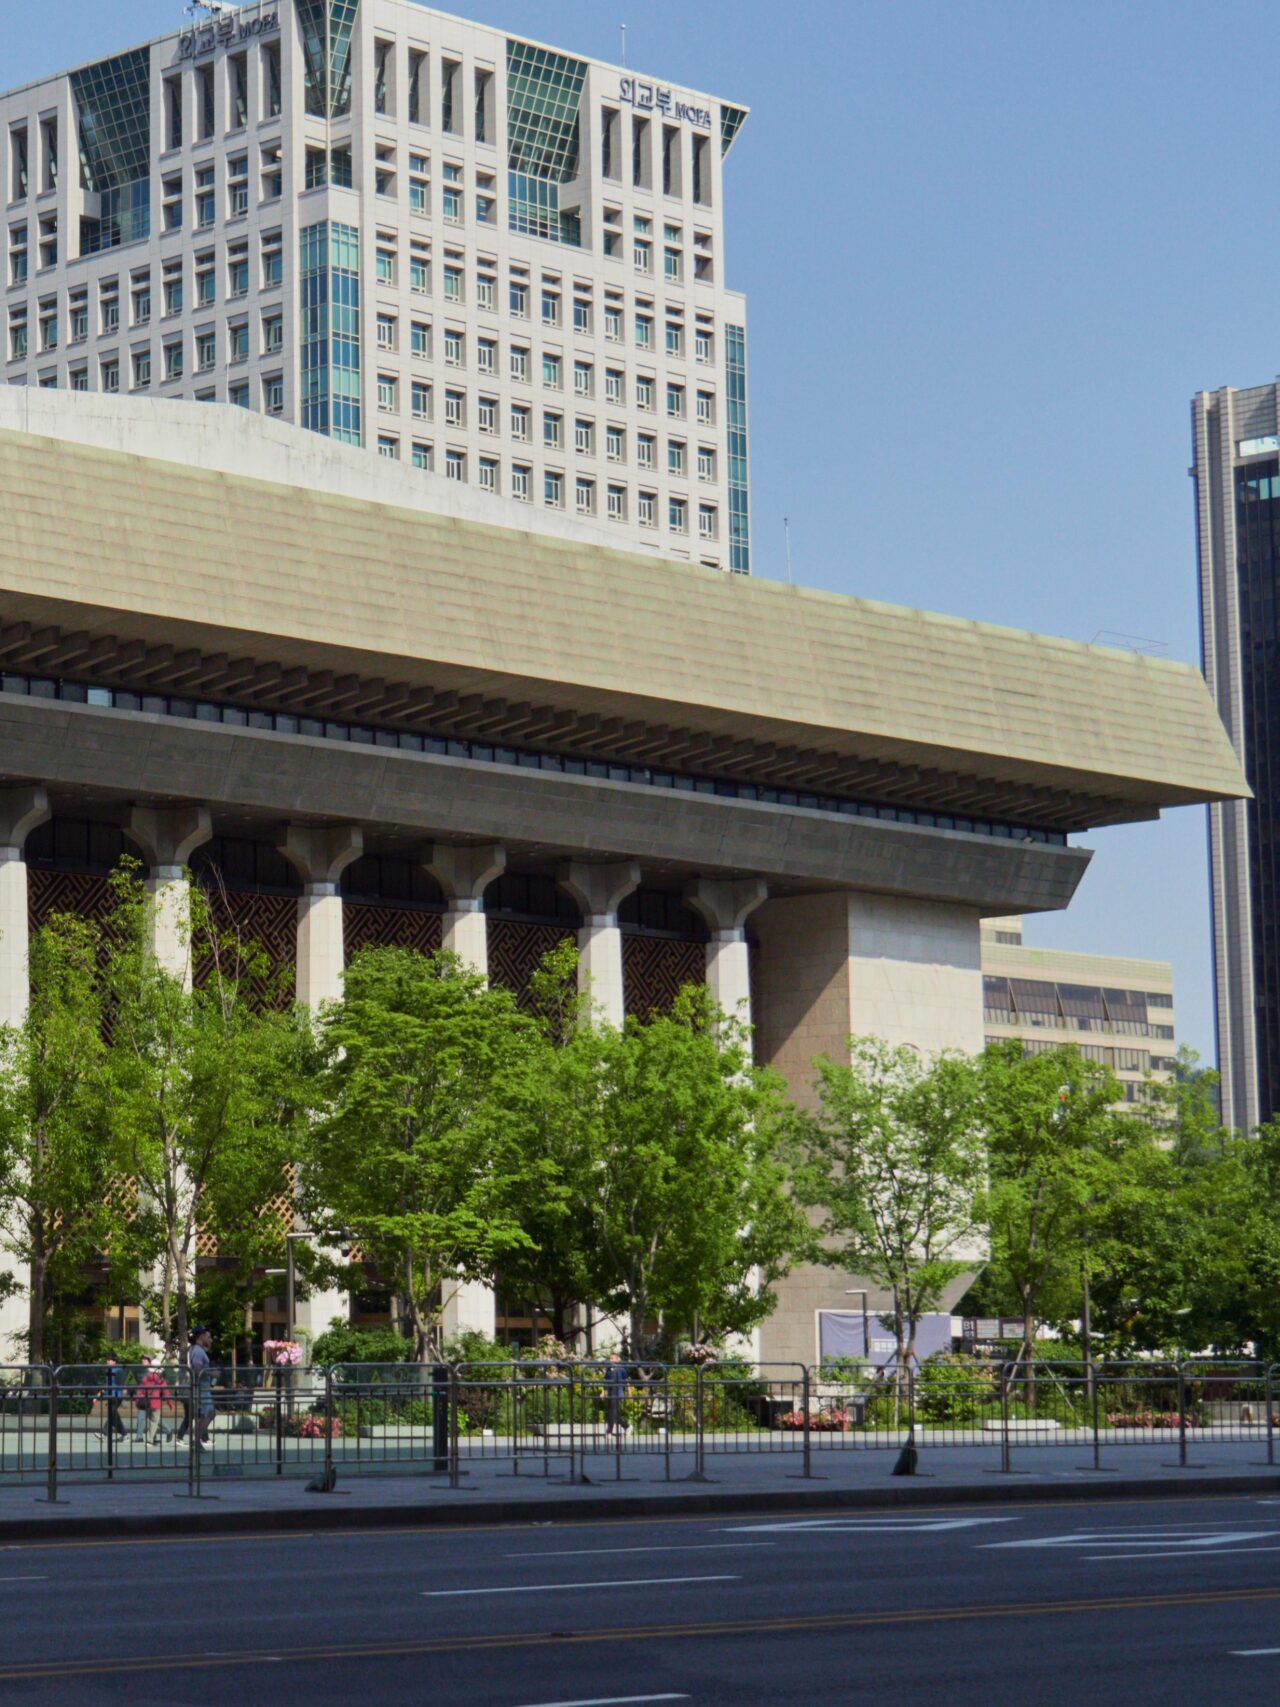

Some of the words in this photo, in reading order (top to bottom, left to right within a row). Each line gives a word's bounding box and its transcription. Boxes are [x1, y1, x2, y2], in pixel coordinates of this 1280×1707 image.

[239, 12, 279, 40] MOFA
[620, 77, 672, 116] 외교부
[675, 101, 711, 126] MOFA
